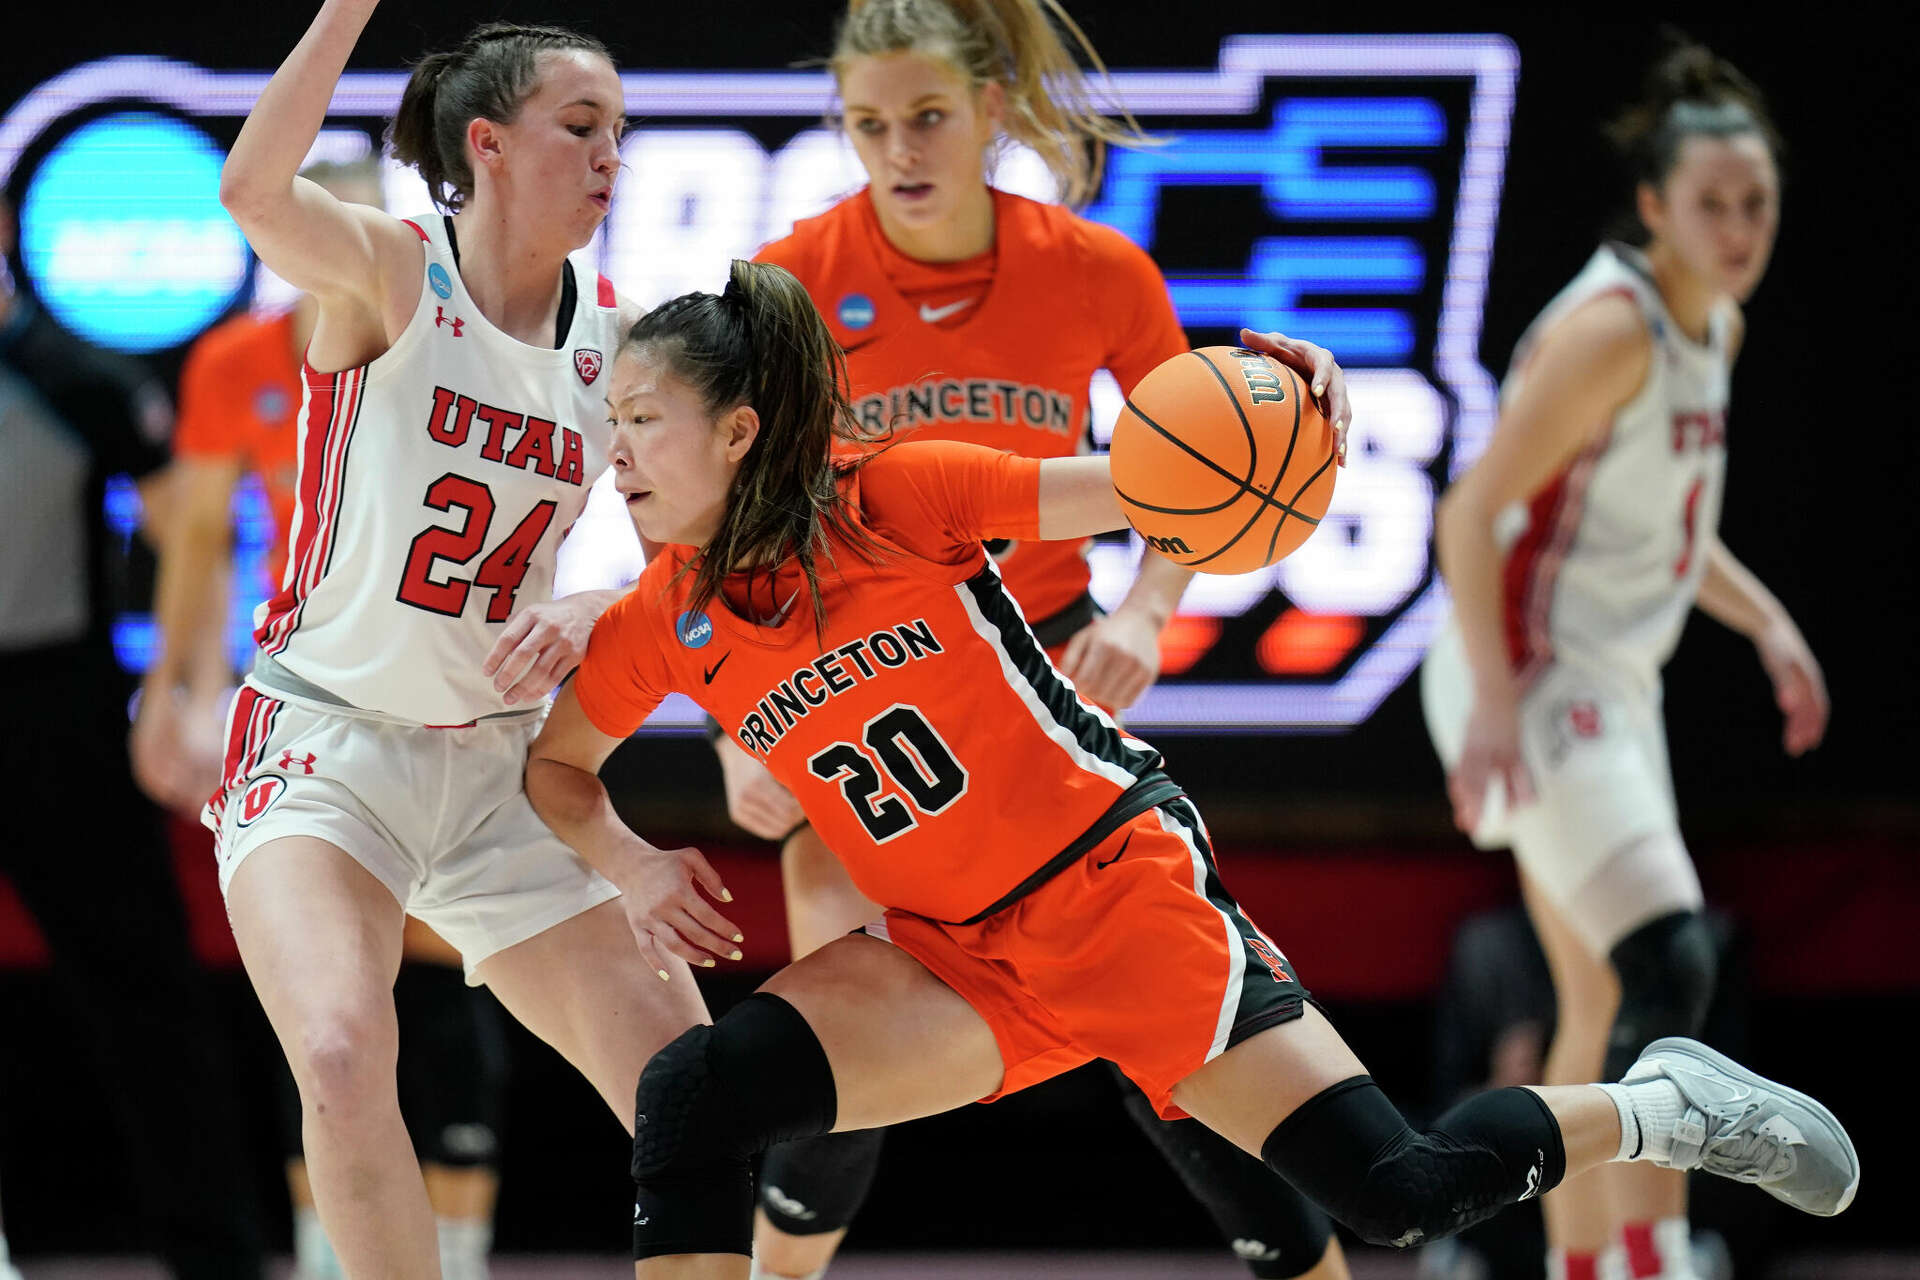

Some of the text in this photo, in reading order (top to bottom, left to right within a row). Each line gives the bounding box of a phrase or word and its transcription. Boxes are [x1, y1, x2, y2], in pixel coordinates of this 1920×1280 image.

[575, 350, 601, 371] PAC
[582, 364, 596, 377] 12
[427, 385, 584, 486] UTAH
[395, 472, 558, 623] 24
[738, 618, 945, 756] PRINCETON
[244, 780, 279, 821] U
[807, 702, 970, 846] 20
